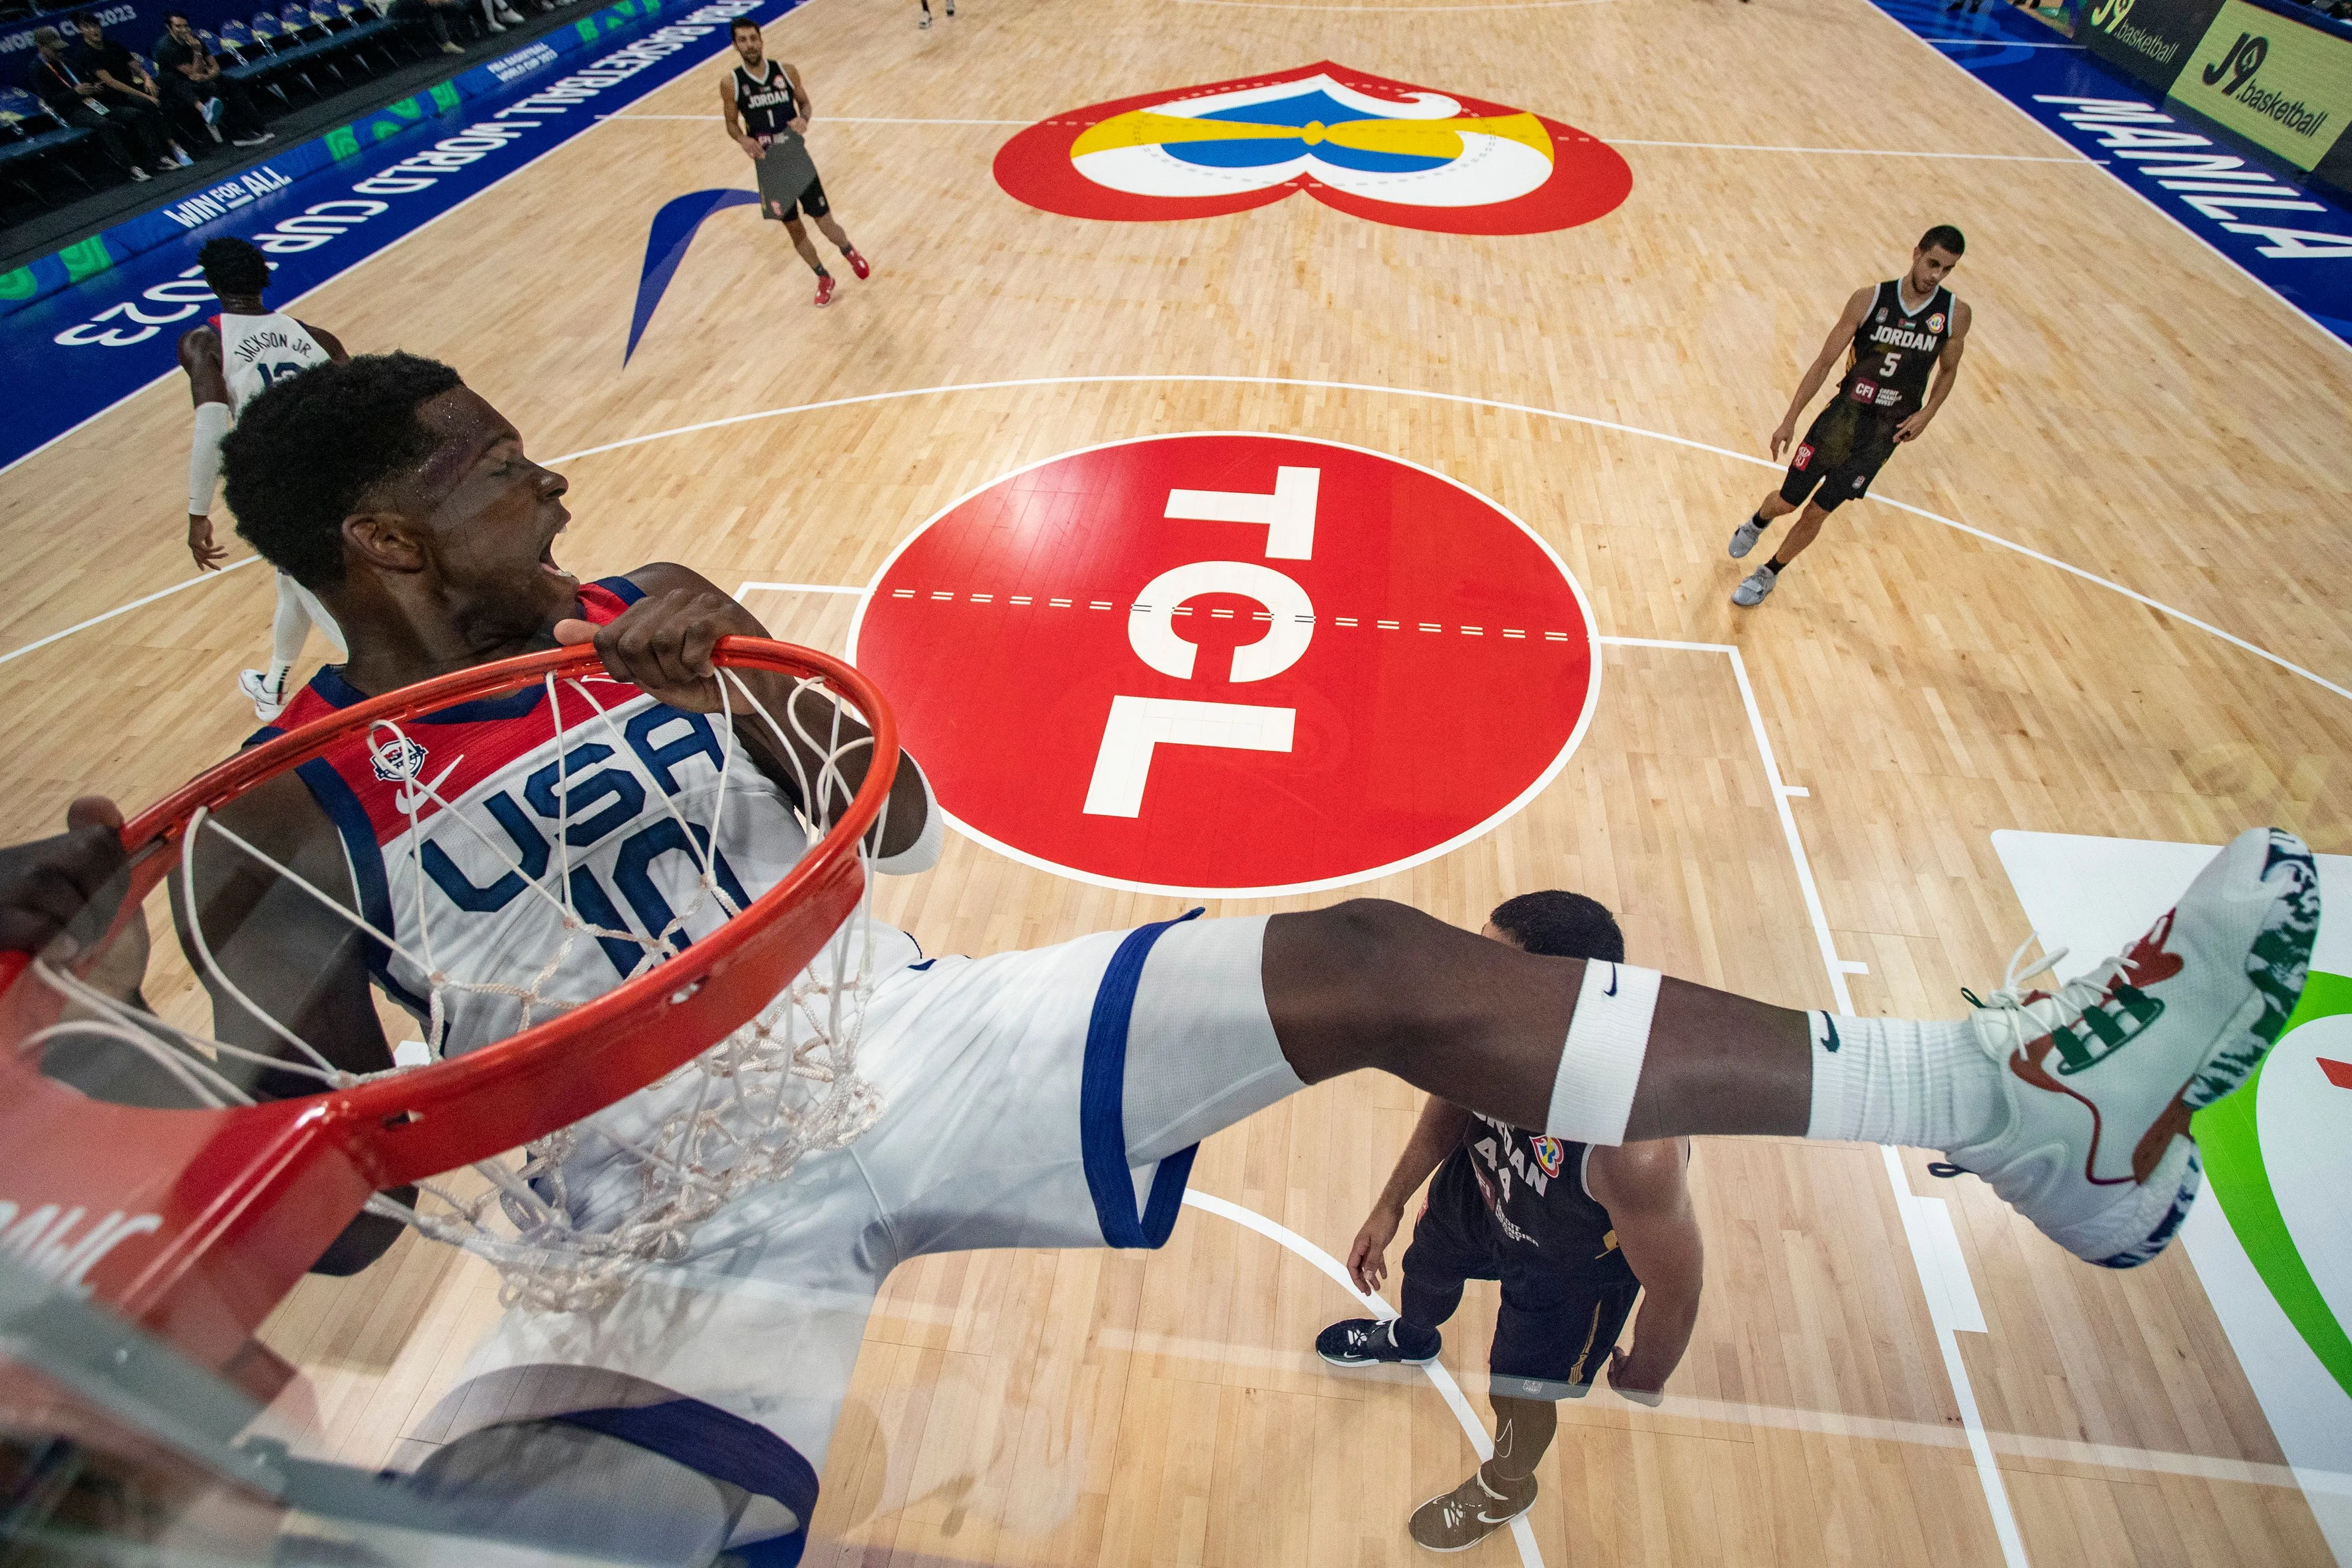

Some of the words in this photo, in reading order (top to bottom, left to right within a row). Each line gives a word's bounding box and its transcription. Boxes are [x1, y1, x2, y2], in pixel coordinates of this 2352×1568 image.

[93, 4, 137, 28] 2023
[2202, 32, 2270, 96] J9
[748, 89, 789, 109] JORDAN
[767, 109, 775, 128] 1
[352, 121, 542, 194] WORLD
[2032, 94, 2352, 258] MANILA
[162, 193, 228, 229] WIN
[209, 181, 247, 203] FOR
[240, 165, 293, 198] ALL
[253, 200, 389, 253] CUP
[54, 262, 279, 347] 023
[234, 332, 289, 363] JACKSON
[1869, 325, 1938, 352] JORDAN
[1879, 353, 1902, 377] 5
[1855, 383, 1875, 399] CFI
[1083, 466, 1320, 818] TCL
[410, 703, 724, 912] USA
[560, 816, 754, 981] 10
